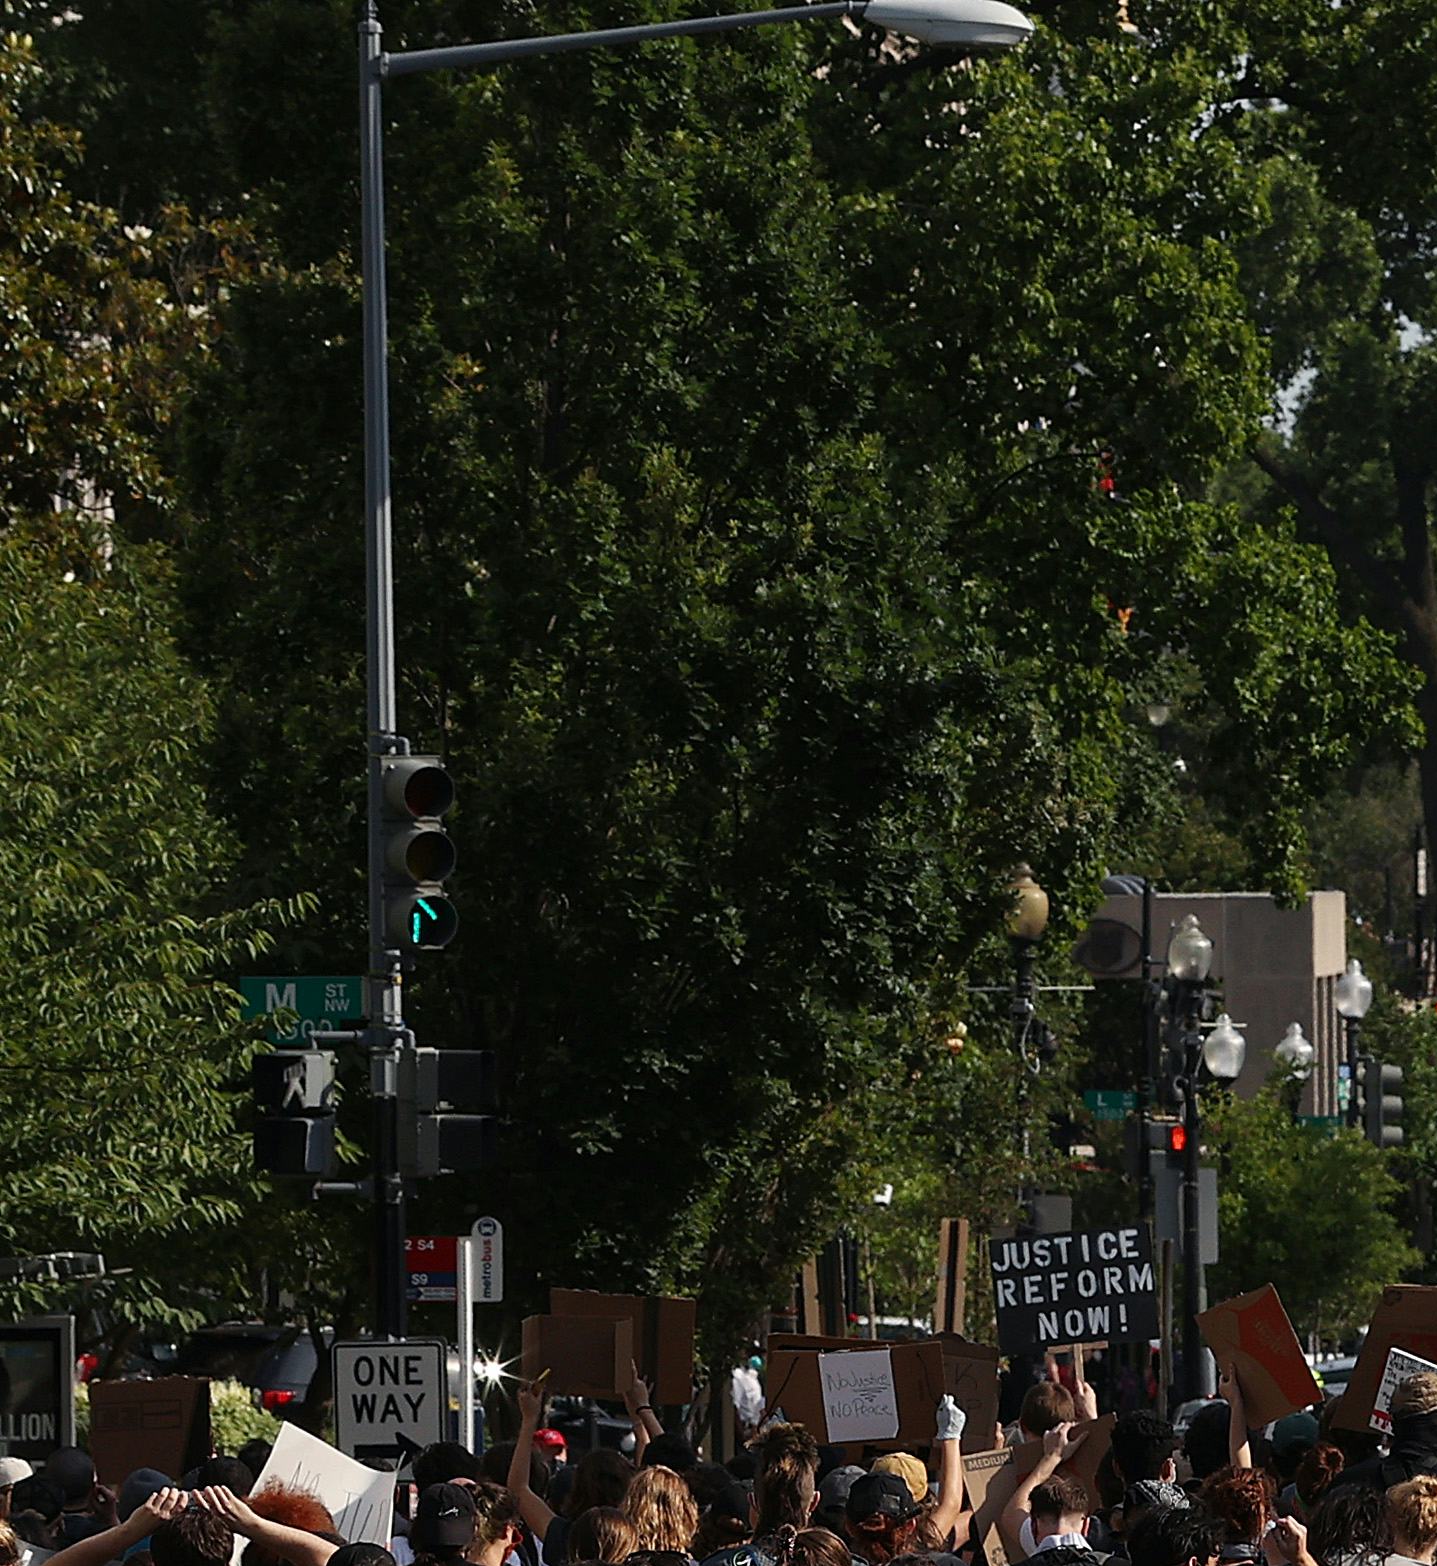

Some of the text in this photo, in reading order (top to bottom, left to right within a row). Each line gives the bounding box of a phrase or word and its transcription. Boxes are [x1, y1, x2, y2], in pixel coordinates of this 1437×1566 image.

[265, 982, 348, 1013] M ST
[325, 999, 350, 1012] NW
[417, 1239, 435, 1251] S4
[992, 1228, 1139, 1272] JUSTICE
[411, 1273, 428, 1286] S9
[483, 1239, 492, 1298] metrobus
[996, 1262, 1154, 1309] REFORM
[1038, 1303, 1128, 1342] NOW!
[354, 1356, 422, 1387] ONE
[353, 1393, 426, 1424] WAY
[966, 1452, 1012, 1473] MEDIUM
